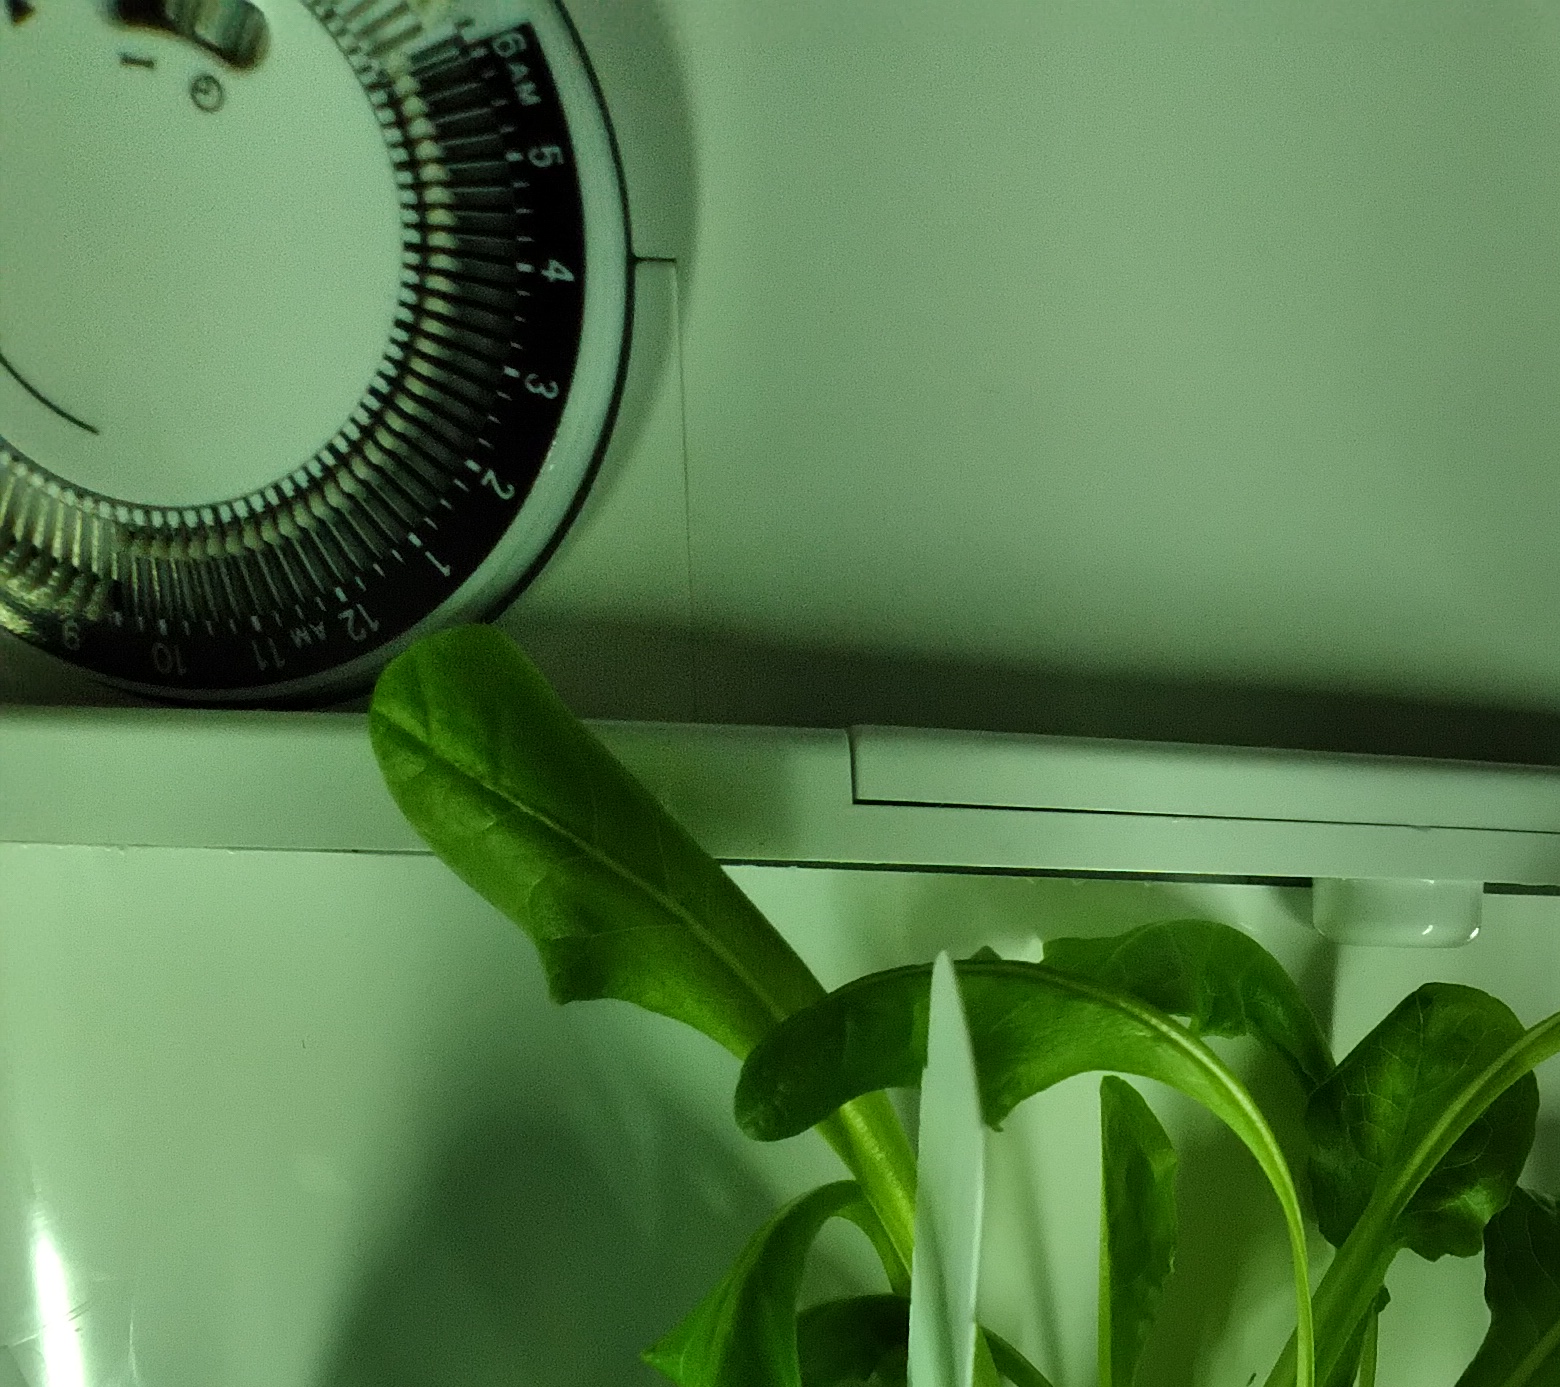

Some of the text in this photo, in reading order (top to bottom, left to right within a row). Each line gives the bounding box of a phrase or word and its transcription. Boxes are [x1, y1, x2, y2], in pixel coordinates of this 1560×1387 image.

[506, 62, 543, 107] AM
[527, 144, 564, 168] 5
[541, 259, 576, 282] 4
[524, 373, 560, 400] 3
[480, 468, 515, 500] 2
[425, 550, 451, 577] 1
[337, 602, 381, 642] 12
[152, 641, 188, 676] 10
[250, 636, 286, 671] 11
